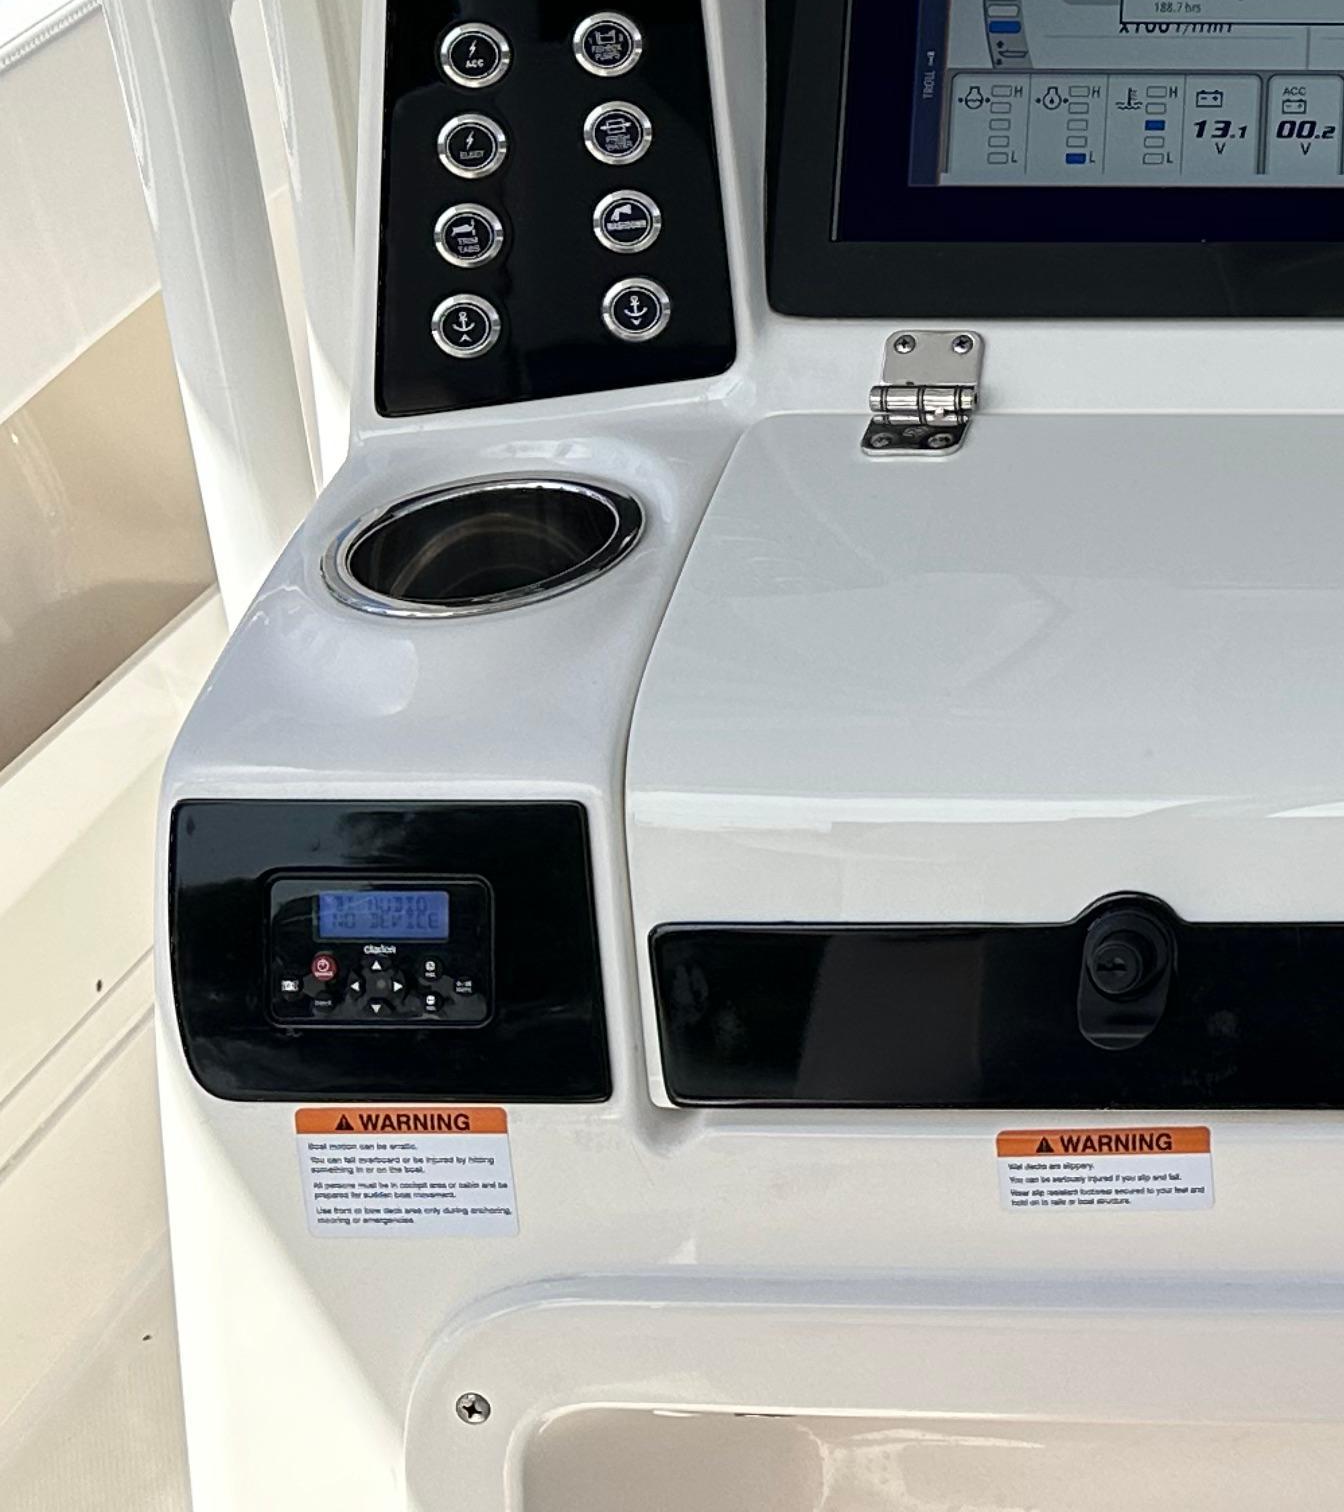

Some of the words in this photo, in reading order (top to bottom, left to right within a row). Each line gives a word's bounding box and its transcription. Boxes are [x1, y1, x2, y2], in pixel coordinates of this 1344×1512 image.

[1193, 121, 1248, 139] 13.1
[1276, 120, 1336, 140] 00.2
[1215, 143, 1225, 154] V
[1301, 143, 1311, 154] V
[359, 1113, 471, 1132] WARNING
[1060, 1133, 1173, 1153] WARNING
